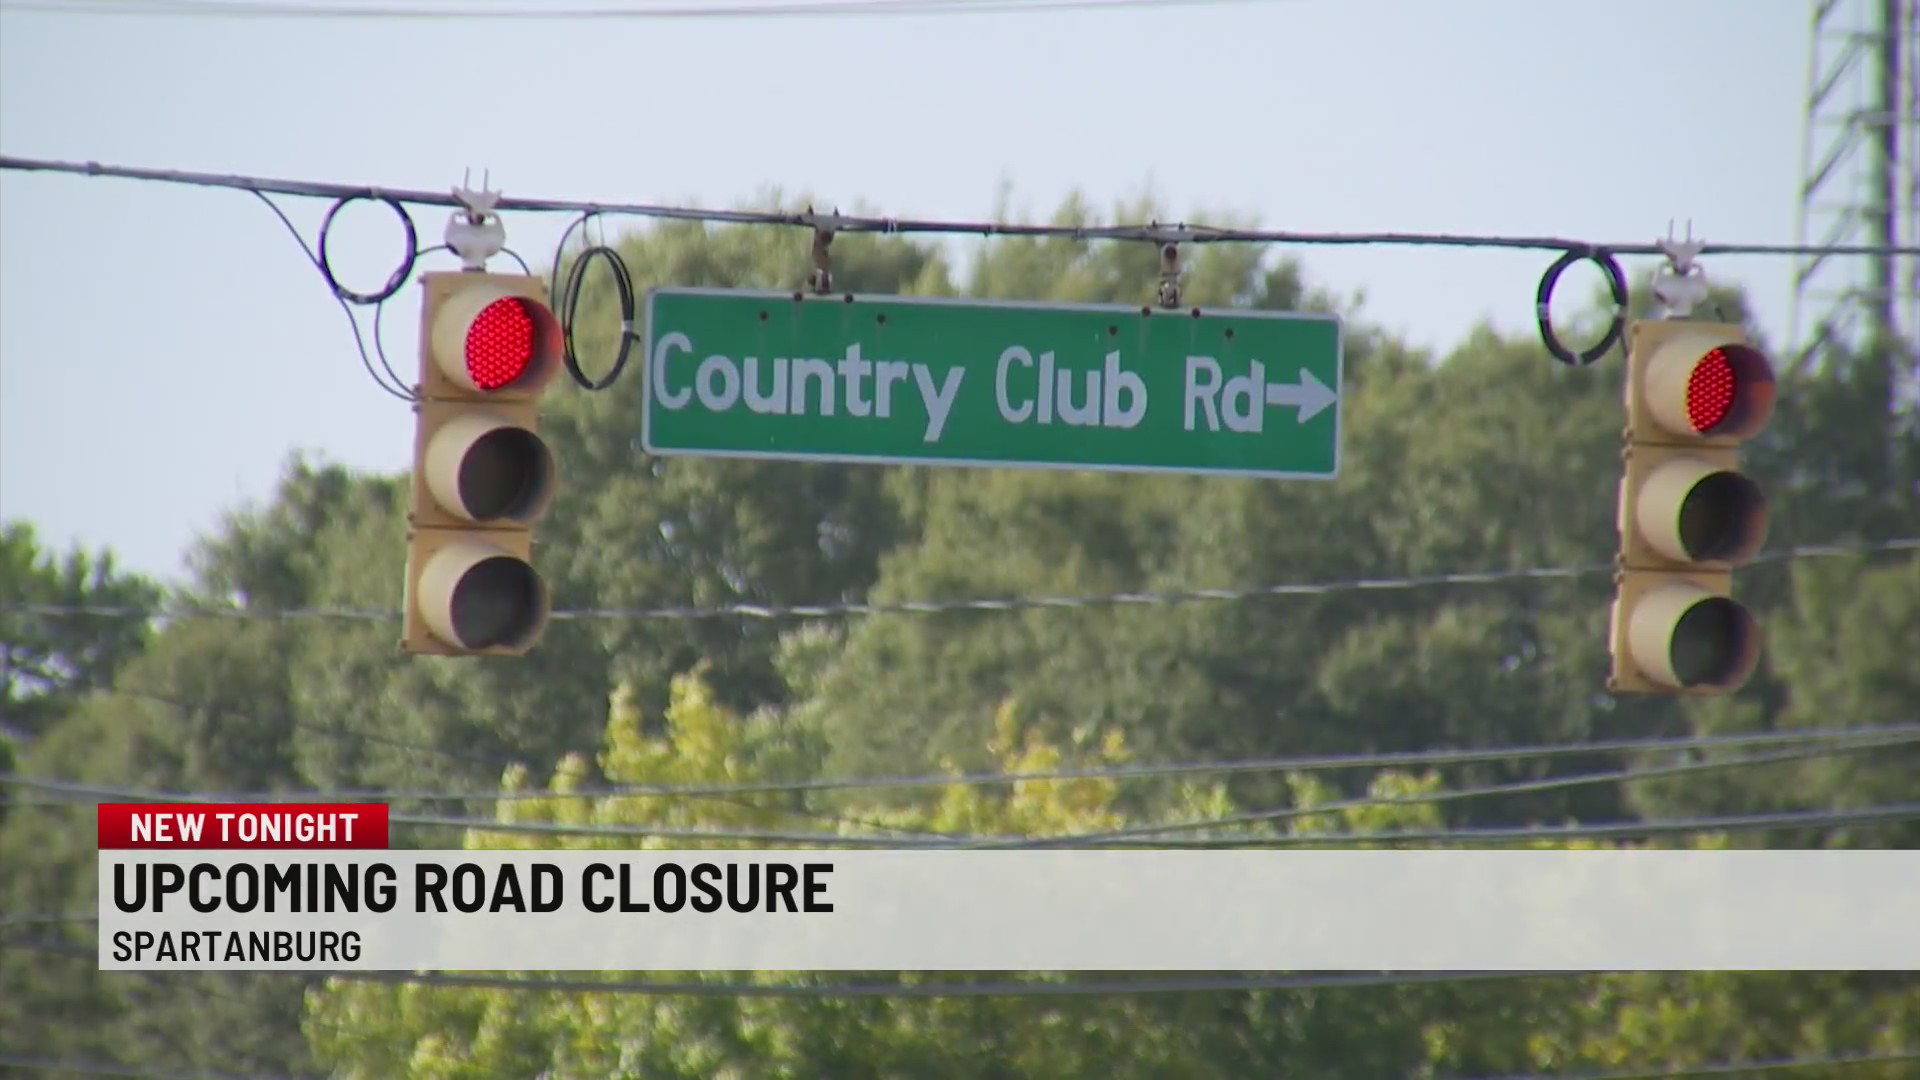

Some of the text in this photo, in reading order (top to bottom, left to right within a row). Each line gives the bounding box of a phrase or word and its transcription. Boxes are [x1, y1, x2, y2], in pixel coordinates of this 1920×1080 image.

[652, 333, 1264, 441] Country Club Rd
